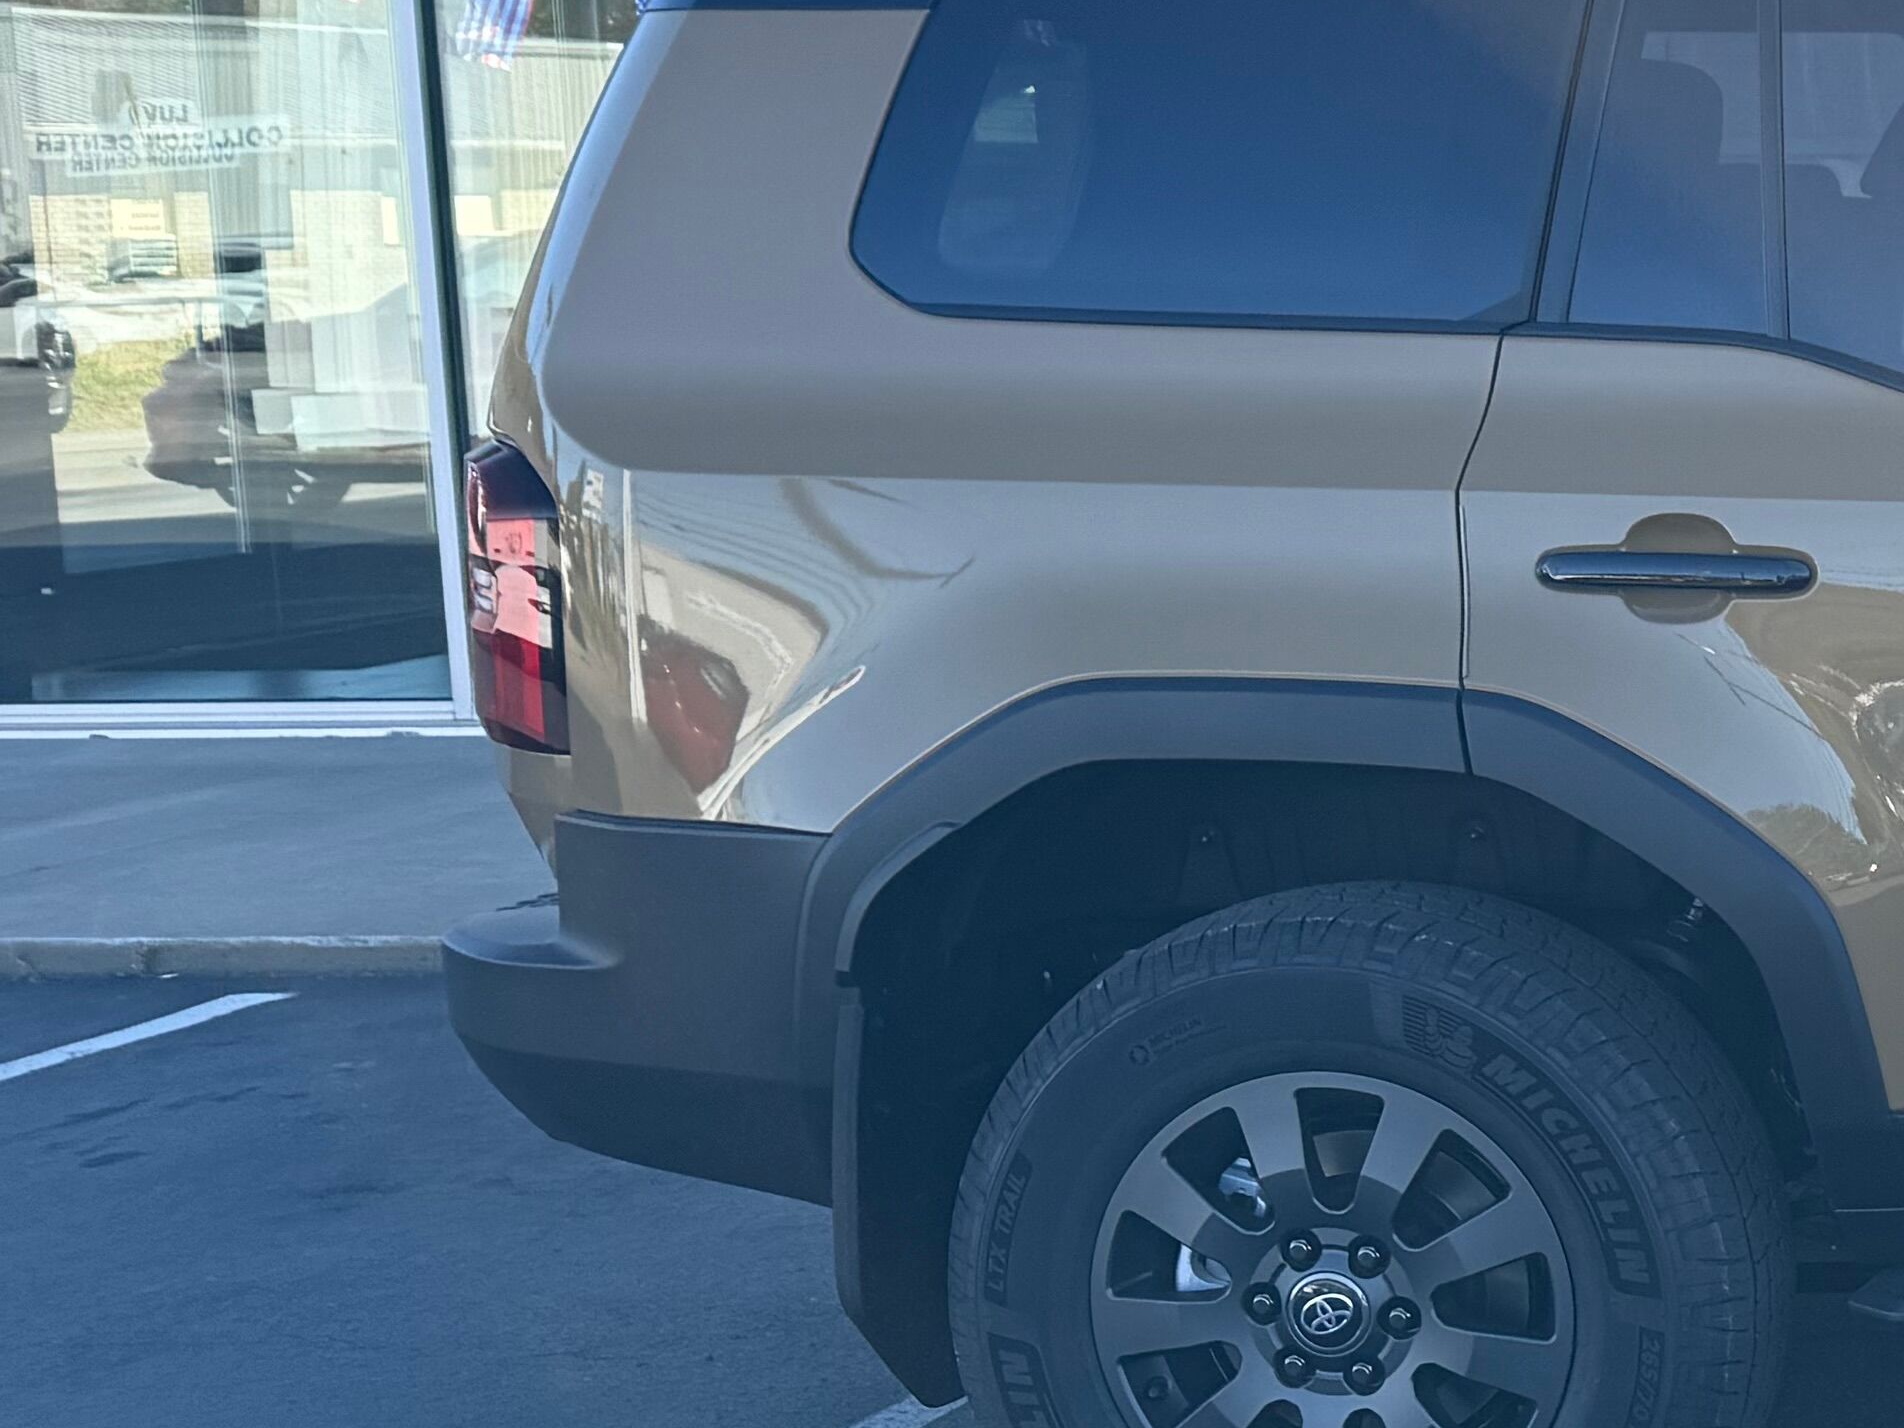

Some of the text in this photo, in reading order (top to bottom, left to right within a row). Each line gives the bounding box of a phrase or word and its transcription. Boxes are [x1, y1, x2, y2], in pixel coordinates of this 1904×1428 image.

[1481, 1052, 1652, 1286] MICHELIN
[988, 1172, 1027, 1293] LTX TRAIL
[1631, 1336, 1661, 1421] 265/70
